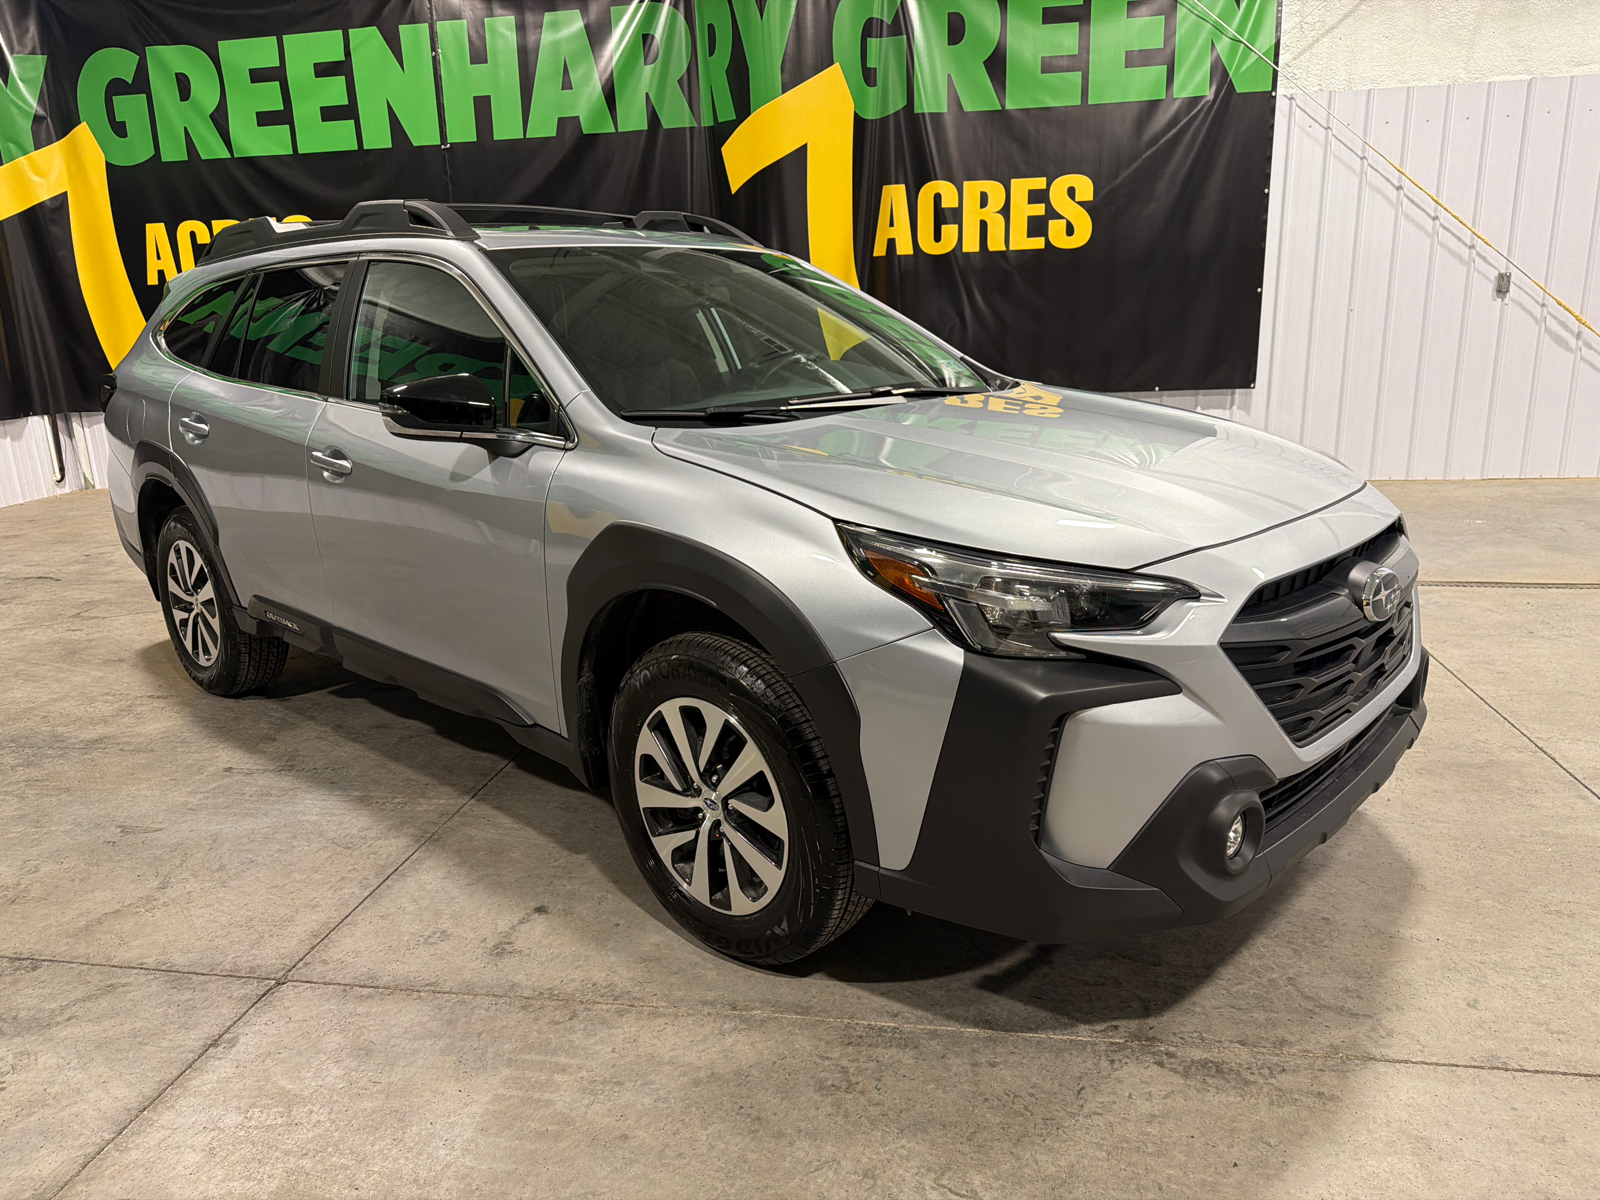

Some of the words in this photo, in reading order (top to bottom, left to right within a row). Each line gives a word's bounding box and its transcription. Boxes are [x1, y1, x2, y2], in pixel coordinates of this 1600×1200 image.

[77, 23, 442, 167] GREEN
[437, 0, 794, 141] HARRY
[832, 0, 1277, 120] GREEN
[721, 62, 860, 290] 7
[873, 174, 1094, 257] ACRES
